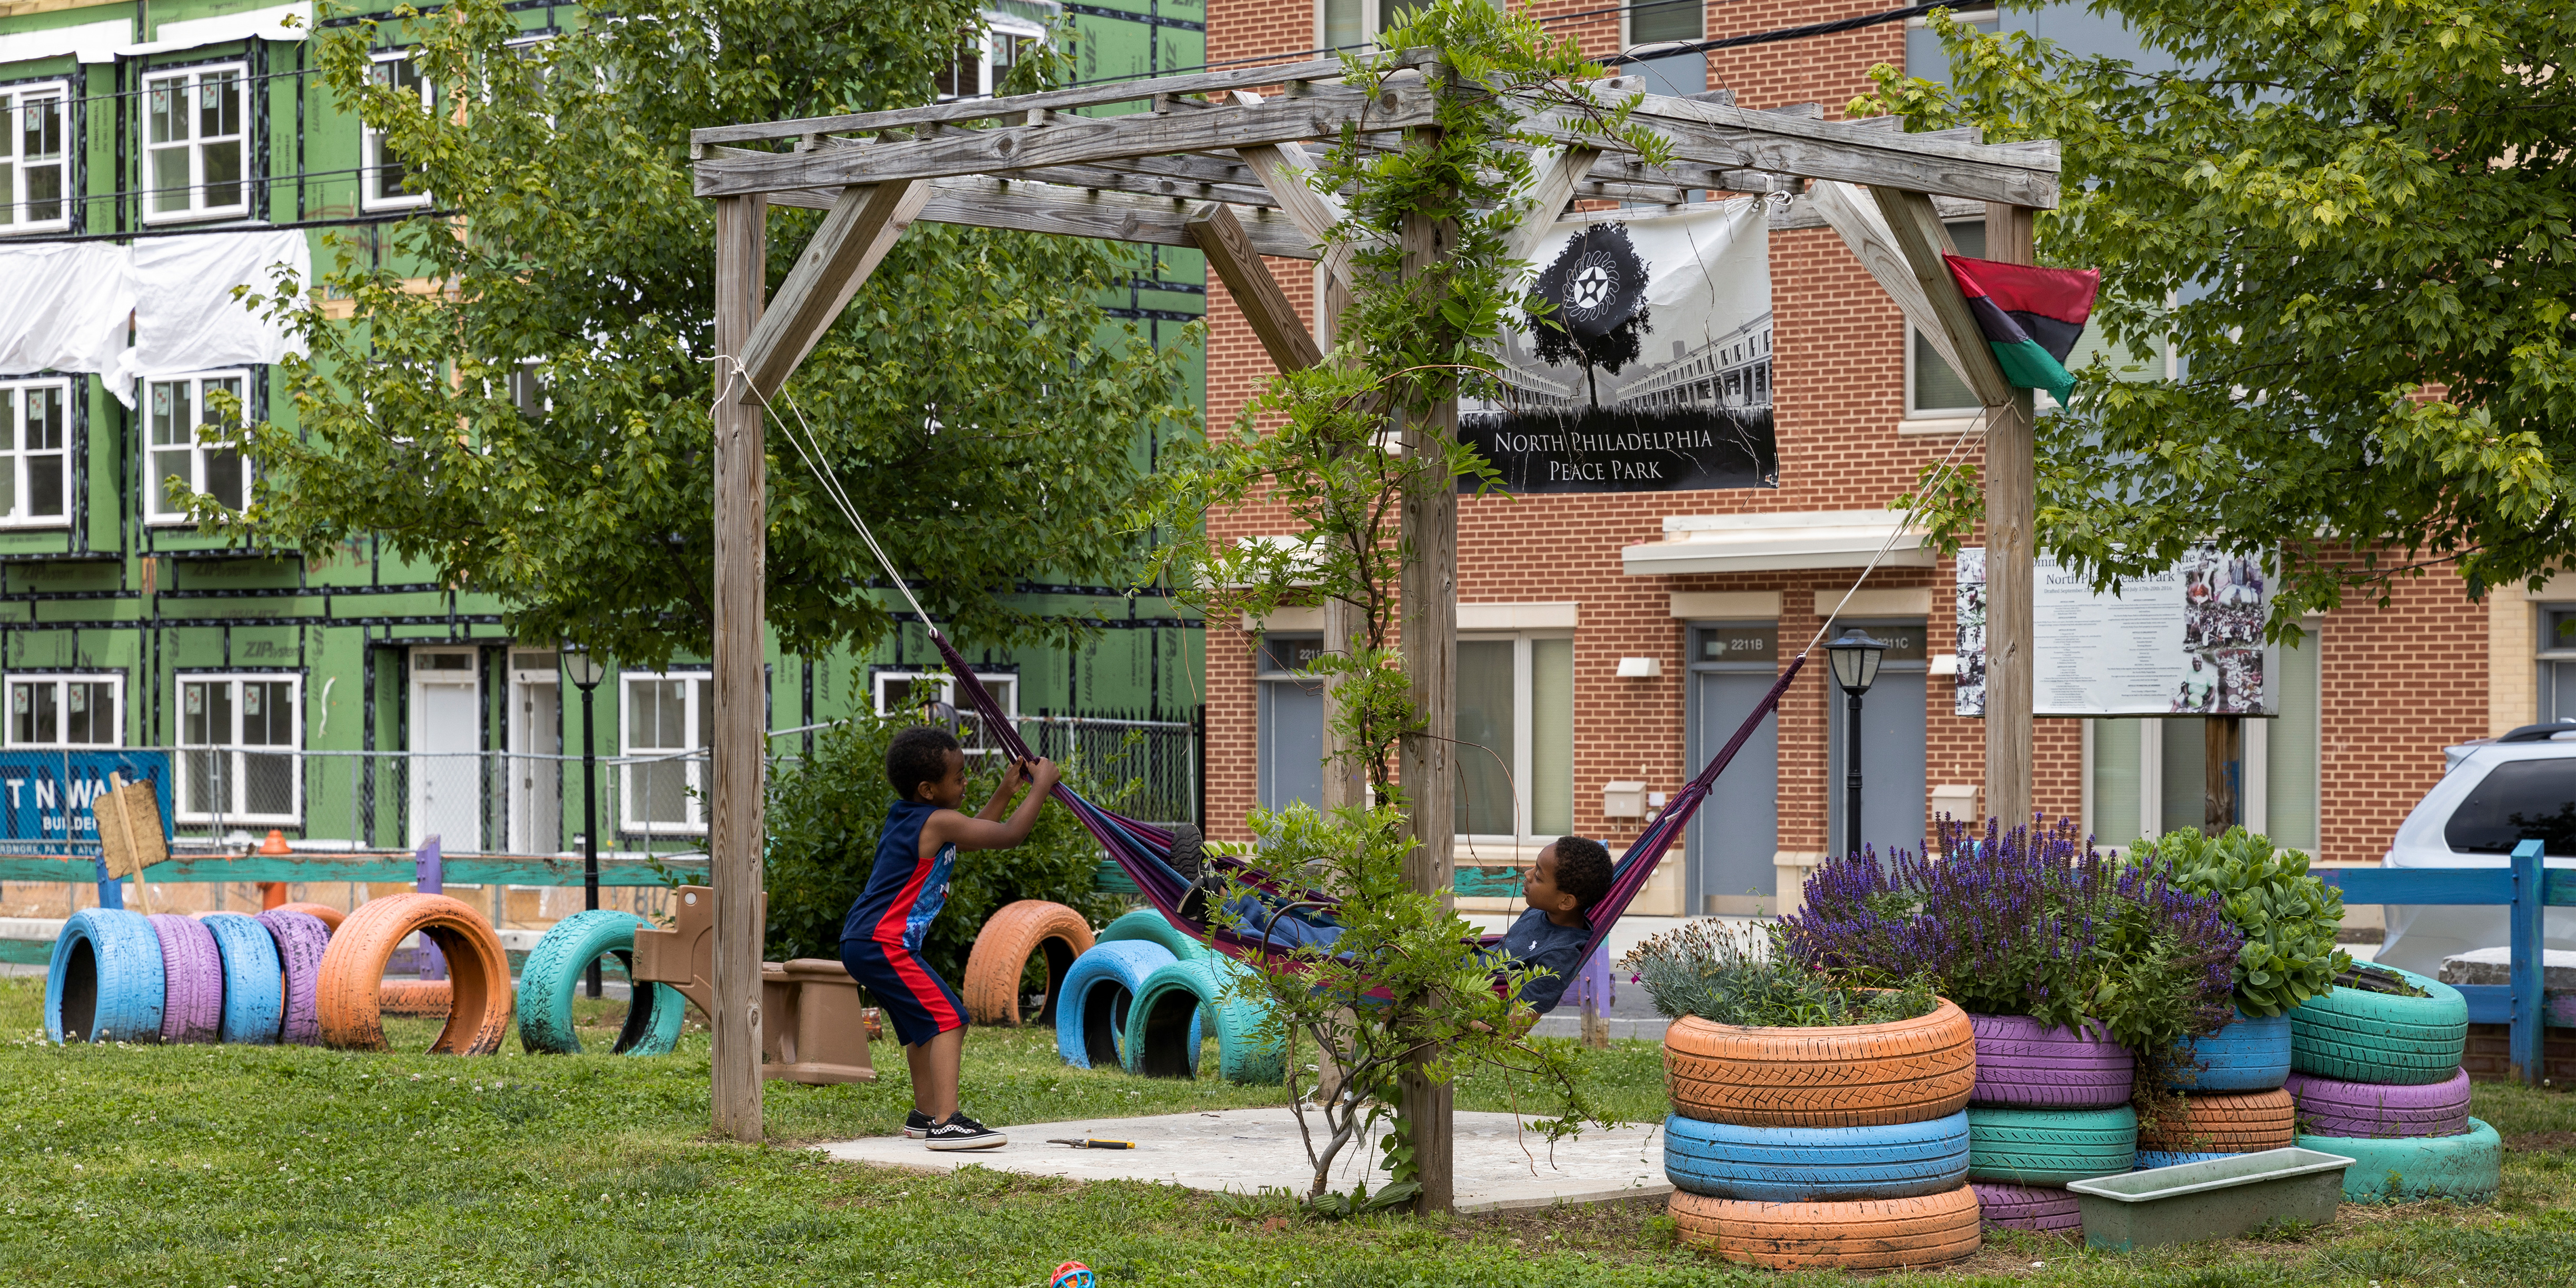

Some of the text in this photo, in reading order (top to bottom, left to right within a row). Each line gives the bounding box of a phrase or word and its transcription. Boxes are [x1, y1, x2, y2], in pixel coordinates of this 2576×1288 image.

[1495, 430, 1713, 452] NORTH PHILADELPHIA
[1550, 460, 1663, 481] PEACE PARK
[2182, 551, 2195, 562] he
[2046, 573, 2078, 584] North
[1731, 638, 1763, 650] 2211B
[35, 779, 56, 809] N
[45, 845, 56, 855] PA
